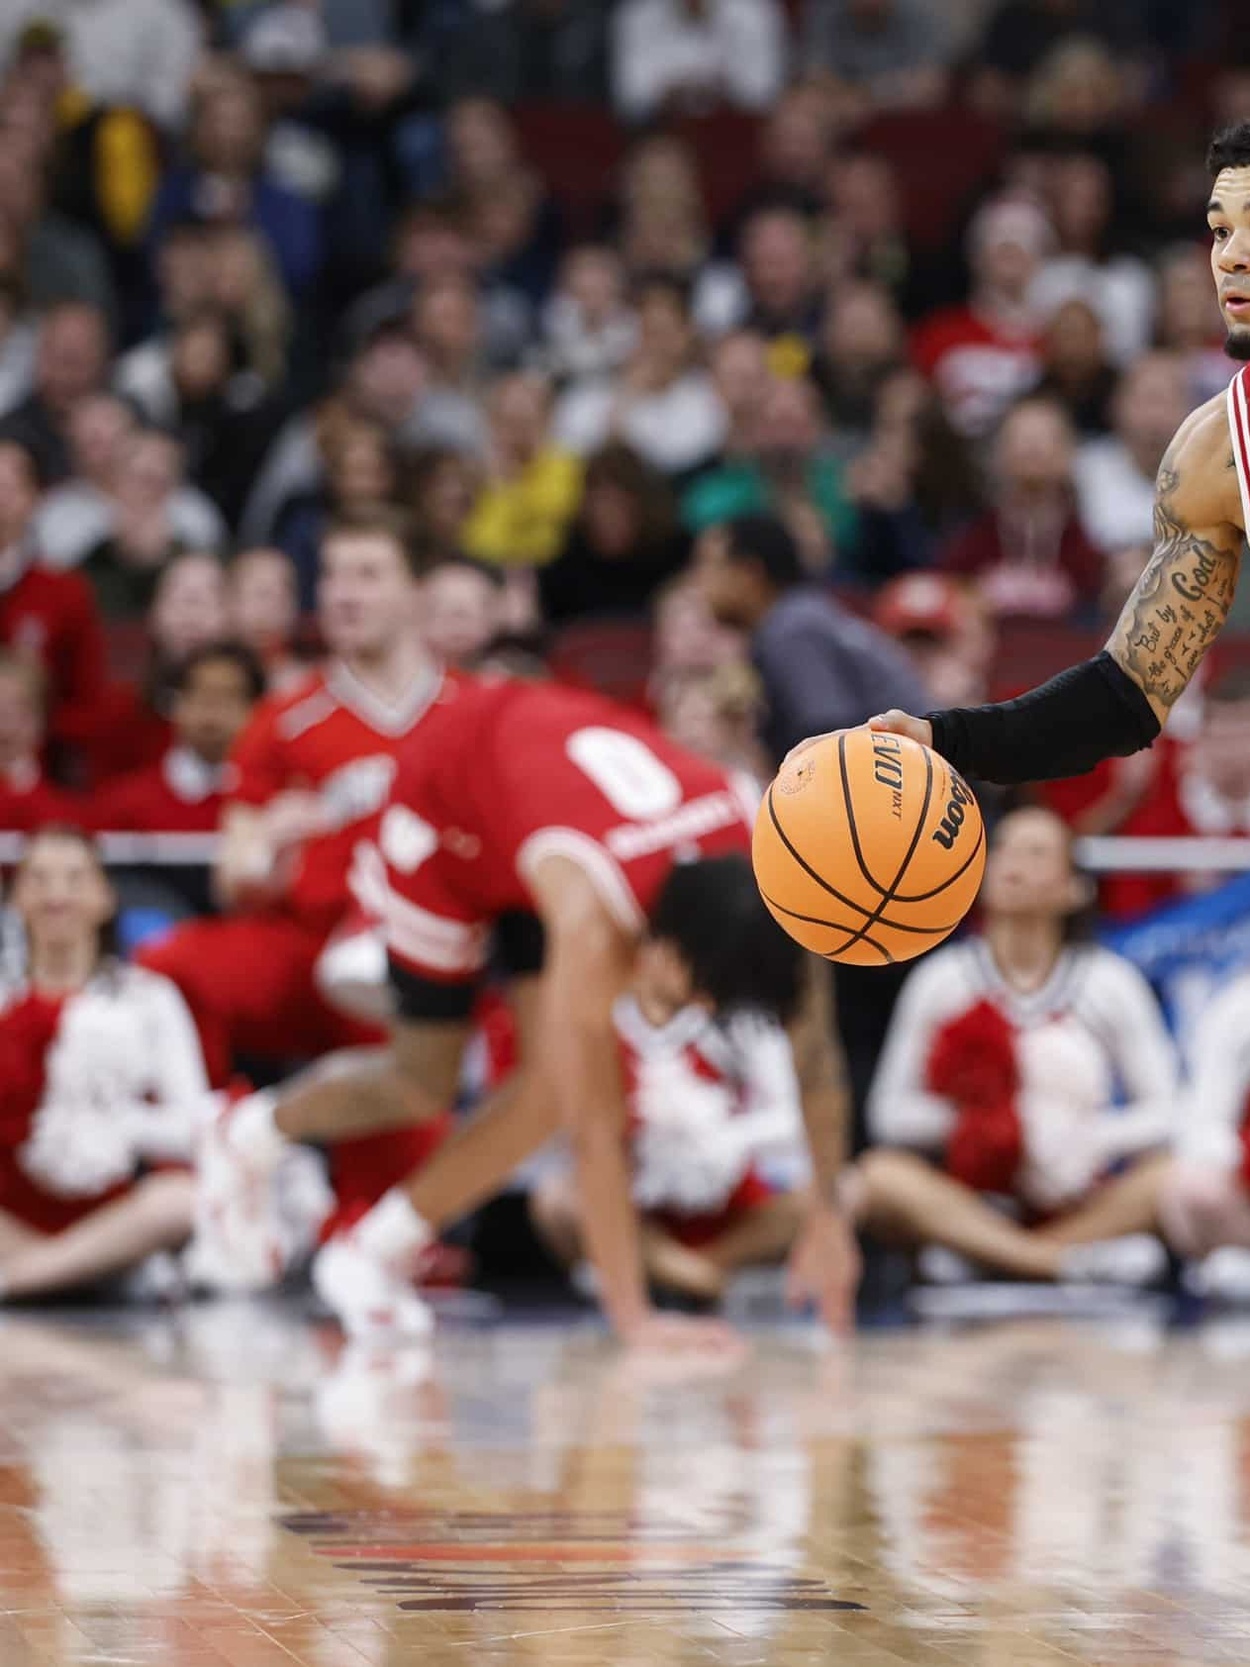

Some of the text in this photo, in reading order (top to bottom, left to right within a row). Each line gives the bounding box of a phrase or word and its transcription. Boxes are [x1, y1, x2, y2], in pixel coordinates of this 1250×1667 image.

[1172, 544, 1217, 601] God
[1134, 605, 1177, 653] But by
[565, 726, 683, 822] 0
[871, 733, 903, 822] EVO NXT
